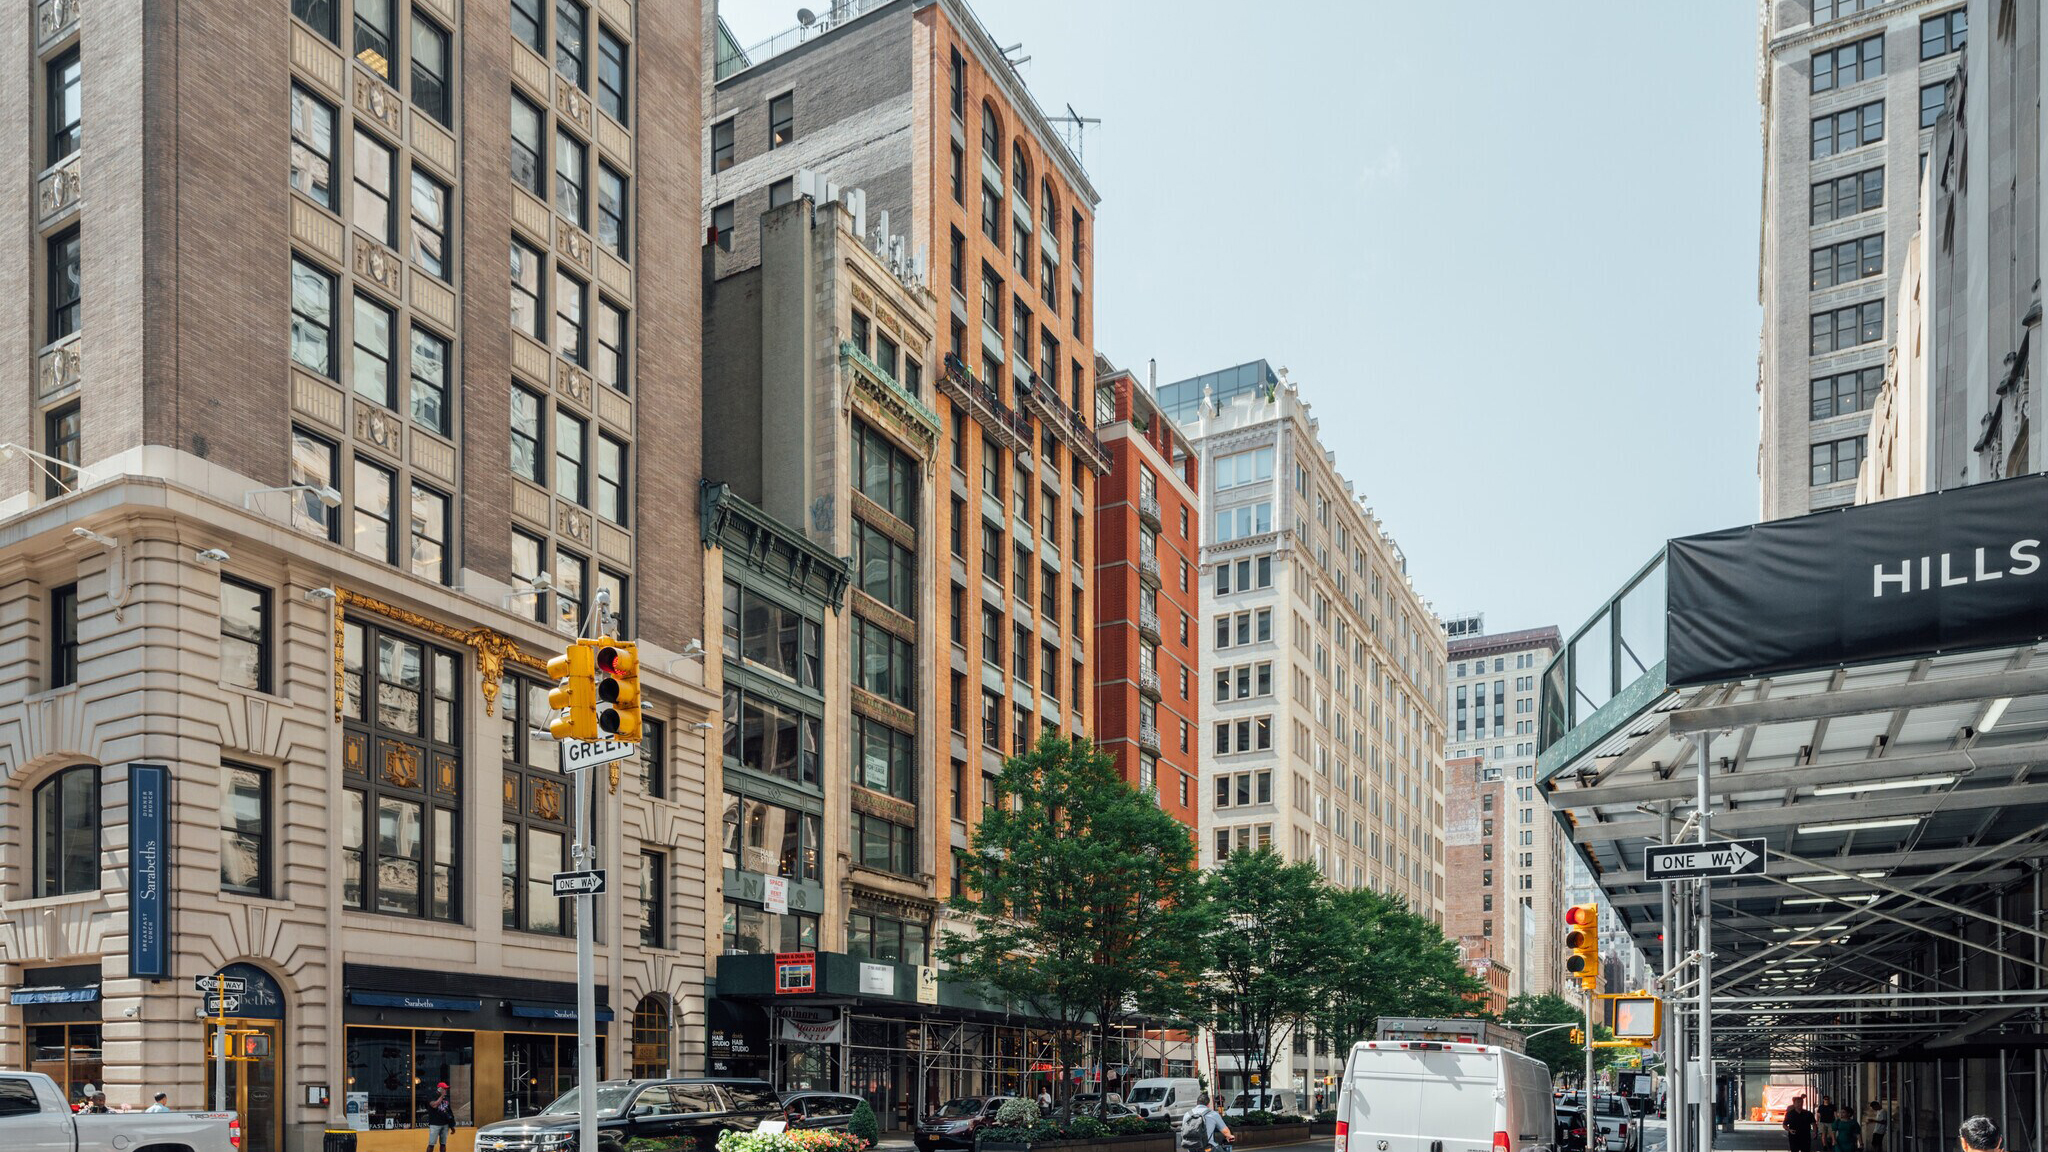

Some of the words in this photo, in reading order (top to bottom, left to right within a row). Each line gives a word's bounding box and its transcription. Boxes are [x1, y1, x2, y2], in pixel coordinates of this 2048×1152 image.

[1873, 539, 2041, 598] HILLS
[1662, 854, 1696, 870] ONE
[1711, 851, 1747, 867] WAY
[139, 840, 156, 900] Sarabeth's
[560, 879, 575, 889] ONE
[580, 877, 598, 887] WAY
[769, 878, 784, 887] SPACE
[225, 981, 242, 989] WAY
[731, 1045, 750, 1053] STUDIO
